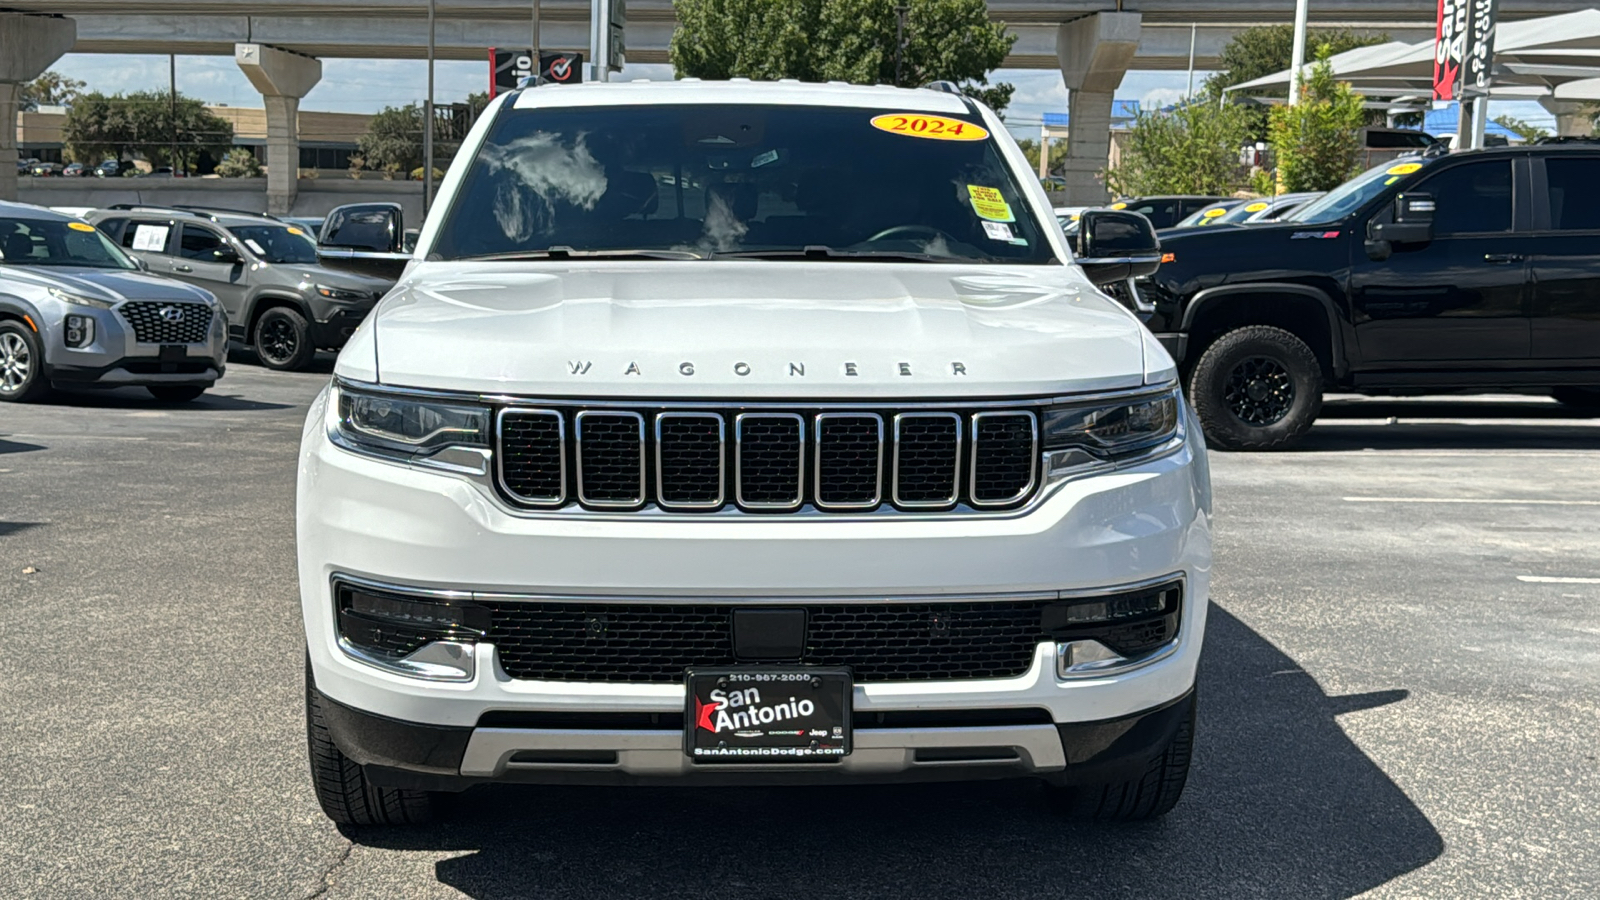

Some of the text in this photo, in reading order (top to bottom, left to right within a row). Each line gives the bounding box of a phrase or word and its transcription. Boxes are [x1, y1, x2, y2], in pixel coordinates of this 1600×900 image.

[891, 117, 964, 135] 2024
[567, 361, 967, 376] WAGONEER
[710, 687, 761, 710] San
[715, 696, 814, 733] Antonio
[809, 729, 828, 737] Jeep
[694, 747, 844, 756] SanAntonioDodge.com
